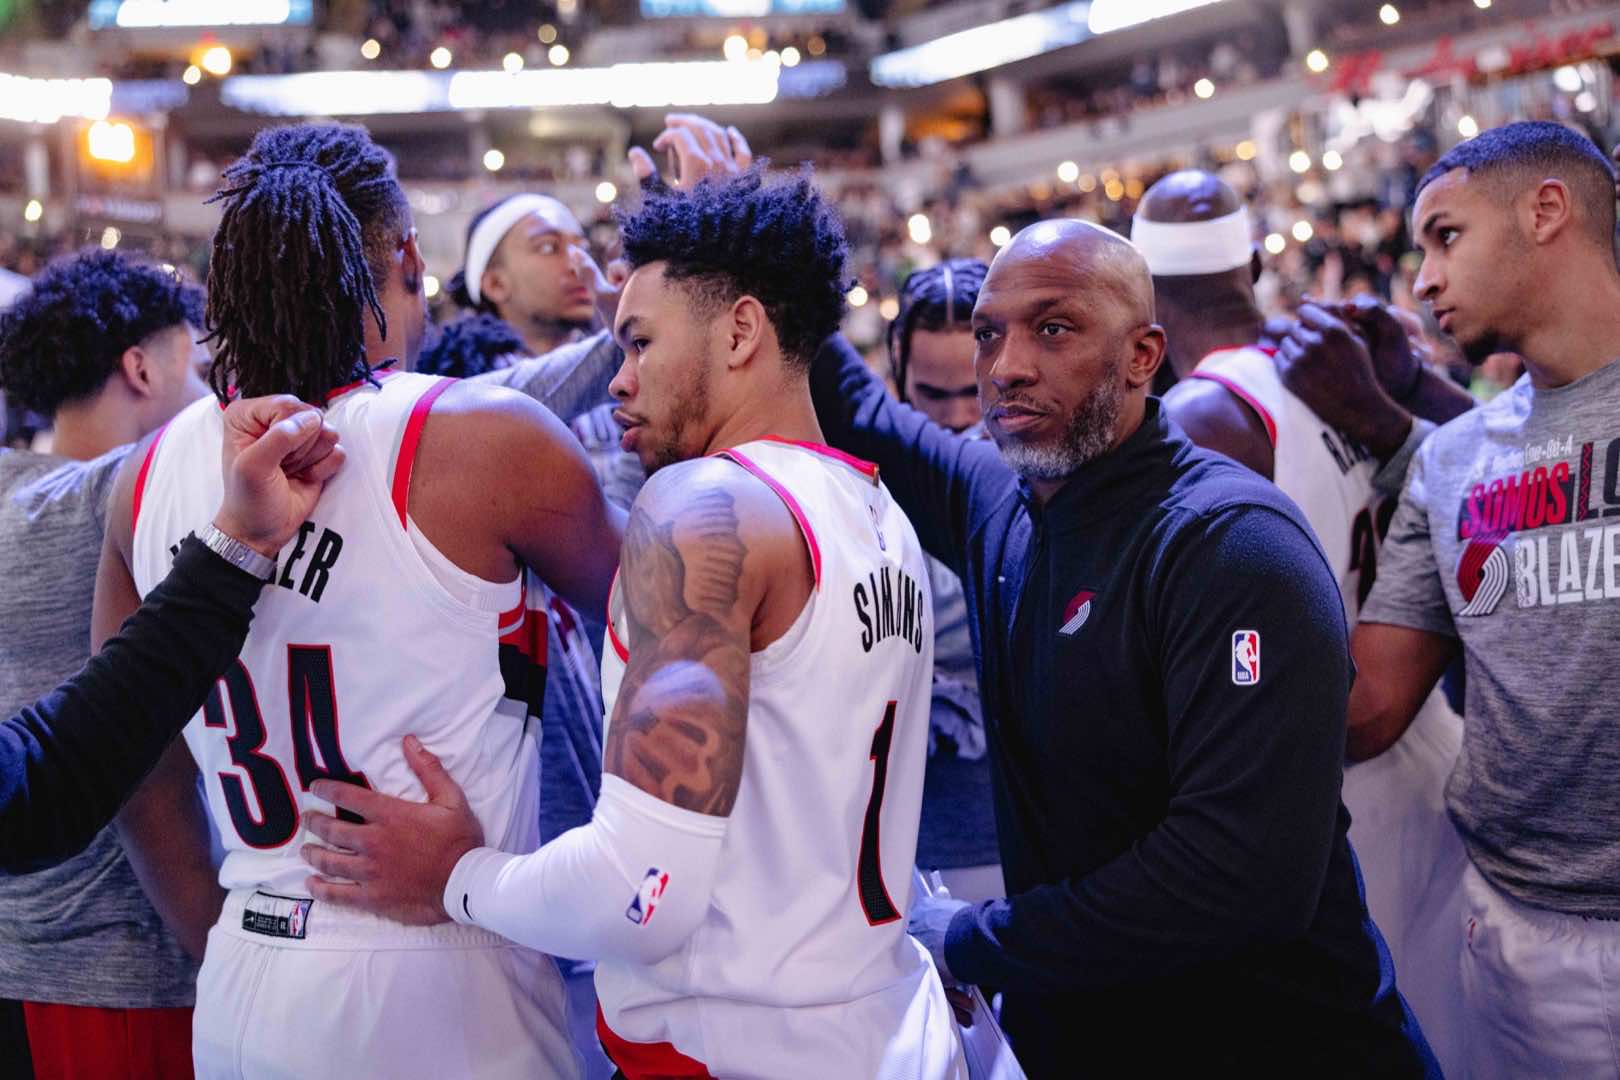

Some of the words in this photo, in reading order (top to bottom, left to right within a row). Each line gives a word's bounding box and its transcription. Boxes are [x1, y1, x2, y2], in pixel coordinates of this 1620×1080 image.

[1459, 461, 1569, 540] SOMOS
[853, 566, 923, 654] SIMONS
[1514, 524, 1620, 608] BLAZE
[203, 643, 374, 850] 34
[857, 700, 902, 927] 1
